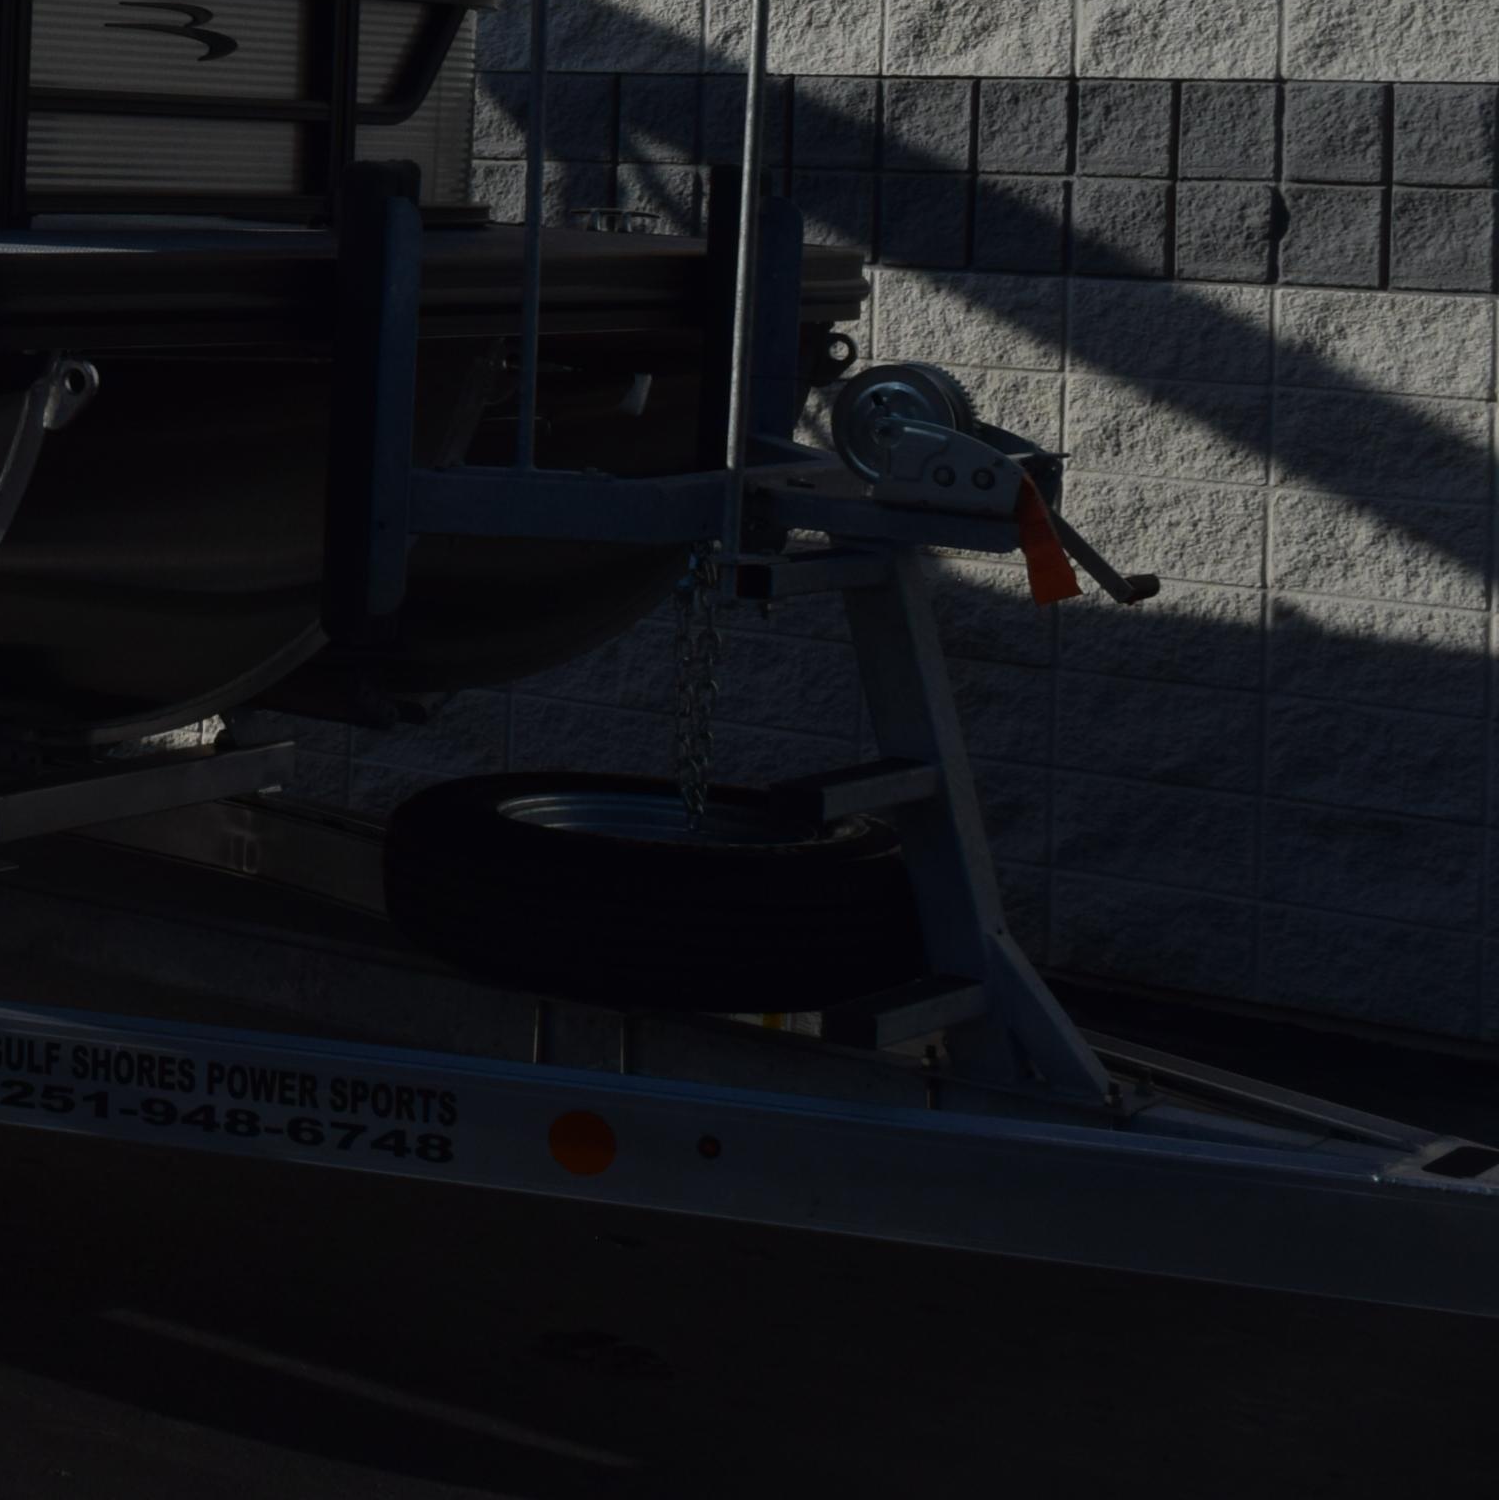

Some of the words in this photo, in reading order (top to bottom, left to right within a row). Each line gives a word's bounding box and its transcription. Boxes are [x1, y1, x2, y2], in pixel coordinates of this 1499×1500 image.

[0, 1079, 454, 1164] 251-948-6748
[72, 1043, 196, 1094] SHORES
[207, 1061, 318, 1109] POWER
[330, 1077, 458, 1128] SPORTS
